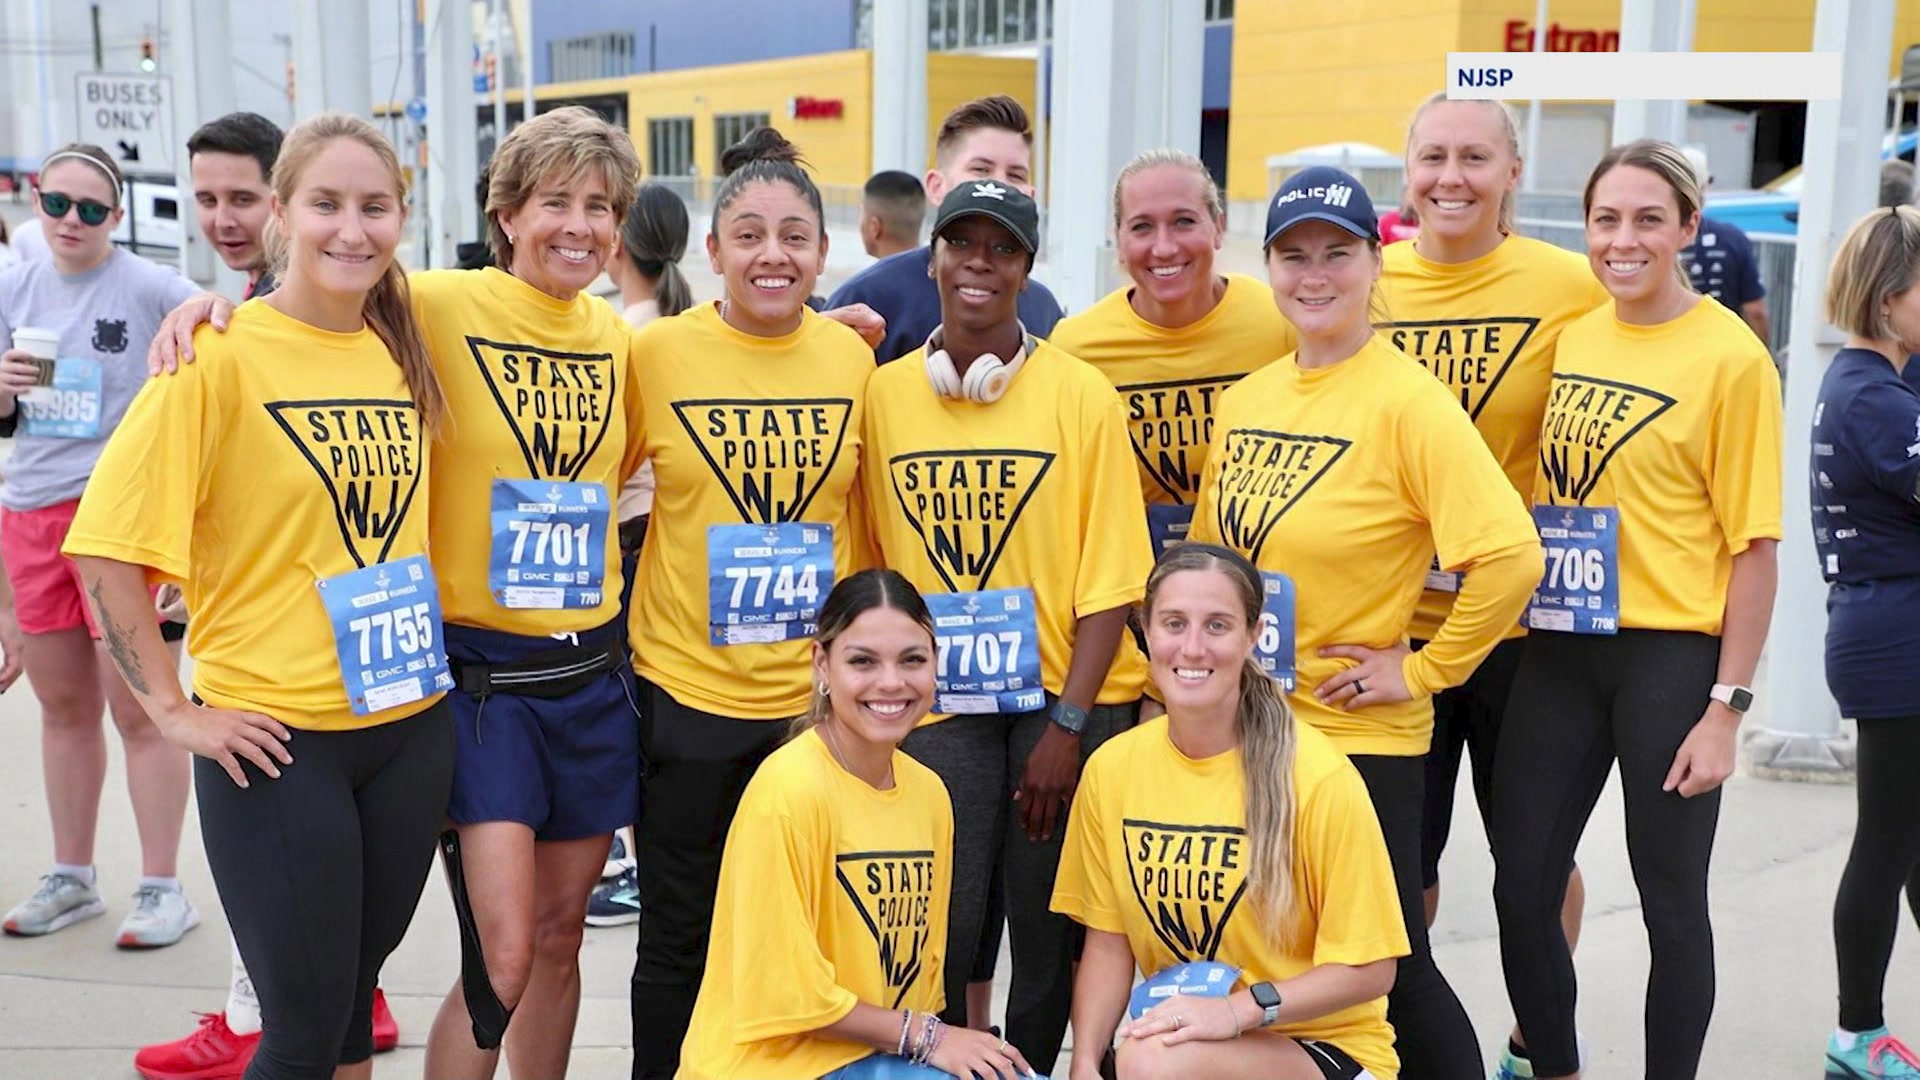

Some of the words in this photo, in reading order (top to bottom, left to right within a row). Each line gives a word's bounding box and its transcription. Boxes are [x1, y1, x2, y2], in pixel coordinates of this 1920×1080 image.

[87, 82, 162, 103] BUSES
[95, 108, 154, 130] ONLY
[1391, 327, 1500, 355] STATE
[502, 354, 602, 390] STATE
[1418, 357, 1488, 385] LICE
[517, 388, 600, 422] POLICE
[1129, 384, 1228, 420] STAT
[1551, 383, 1635, 422] STATE
[307, 410, 412, 442] STATE
[708, 408, 829, 437] STATE
[1142, 417, 1214, 448] POLIC
[1544, 411, 1612, 450] POLICE
[329, 444, 413, 478] POLICE
[533, 422, 587, 477] NJ
[724, 439, 822, 469] POLICE
[1232, 437, 1316, 471] STATE
[905, 459, 1016, 491] STATE
[1225, 467, 1297, 499] POLICE
[1551, 443, 1590, 500] NJ
[345, 480, 399, 538] NJ
[743, 471, 805, 524] NJ
[916, 492, 1006, 522] POLICE
[1225, 496, 1271, 549] NJ
[508, 520, 590, 566] 7701
[933, 524, 991, 576] NJ
[523, 572, 551, 581] GMC
[725, 564, 819, 608] 7744
[1541, 547, 1605, 591] 706
[580, 592, 600, 605] 7701
[349, 602, 432, 666] 7755
[935, 631, 1022, 677] 7707
[376, 665, 404, 679] GMC
[1016, 692, 1041, 708] 7707
[1138, 831, 1240, 869] STATE
[866, 862, 933, 895] STATE
[1144, 866, 1225, 902] POLICE
[878, 896, 929, 929] POLICE
[1157, 900, 1213, 955] NJ
